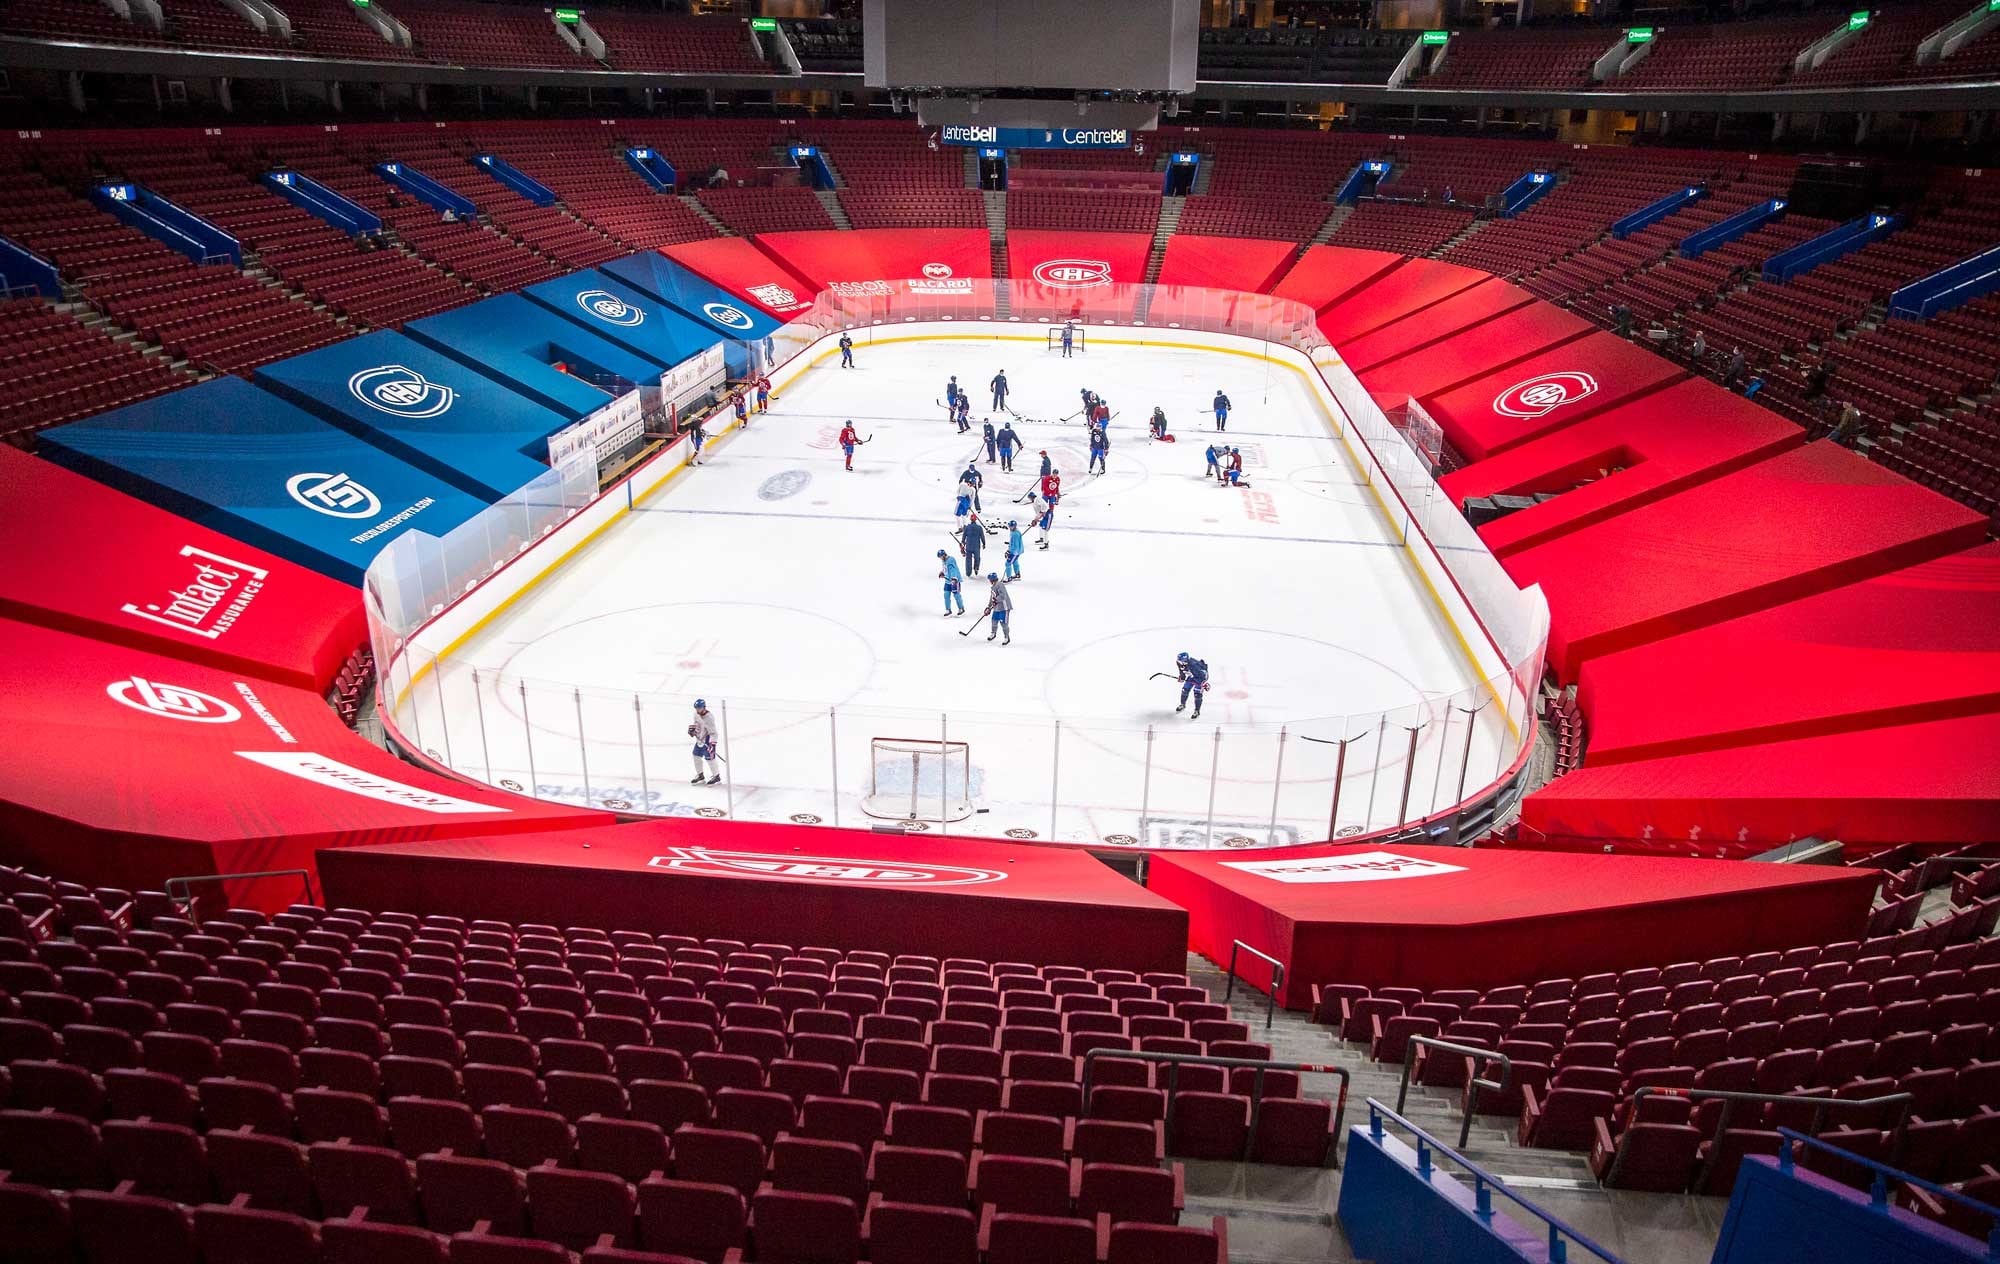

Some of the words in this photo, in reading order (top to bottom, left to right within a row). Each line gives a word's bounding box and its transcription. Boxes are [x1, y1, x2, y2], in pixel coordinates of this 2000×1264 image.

[828, 280, 890, 292] ESSOR
[908, 278, 972, 289] BACARDÍ
[213, 580, 264, 633] ASSURANCE
[1909, 1200, 1919, 1214] N
